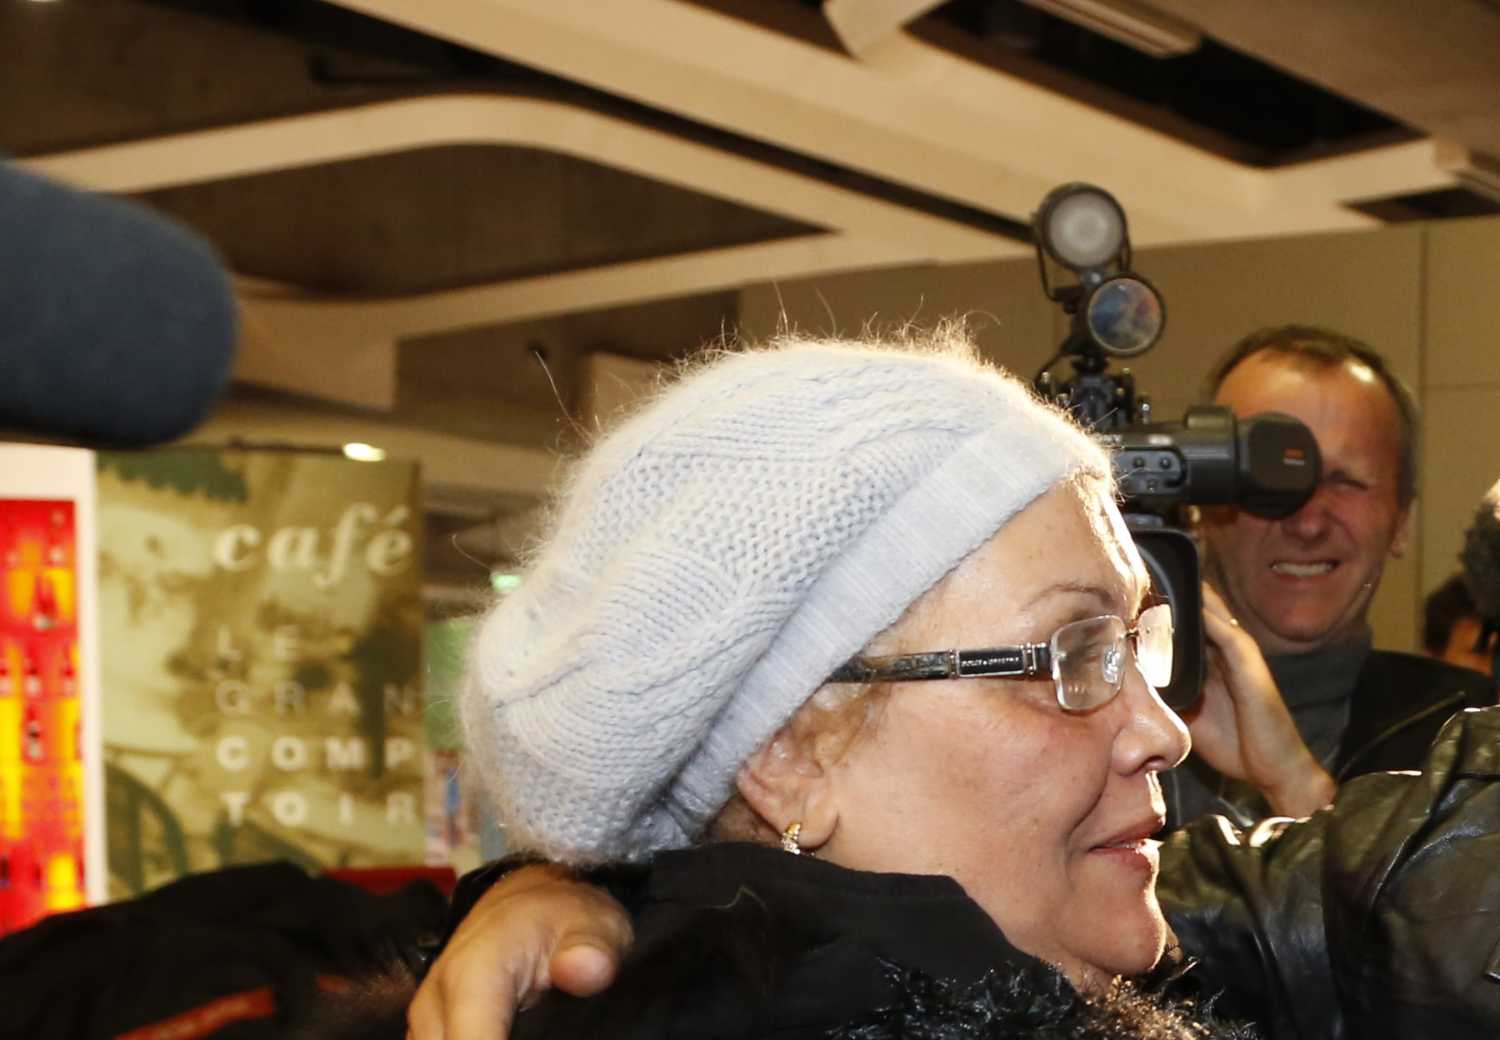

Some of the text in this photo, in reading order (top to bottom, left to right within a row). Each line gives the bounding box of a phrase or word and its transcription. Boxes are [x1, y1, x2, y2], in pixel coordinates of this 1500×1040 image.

[214, 502, 412, 586] café
[218, 626, 298, 661] LE
[216, 735, 415, 771] COMP
[221, 790, 416, 826] TOIR
